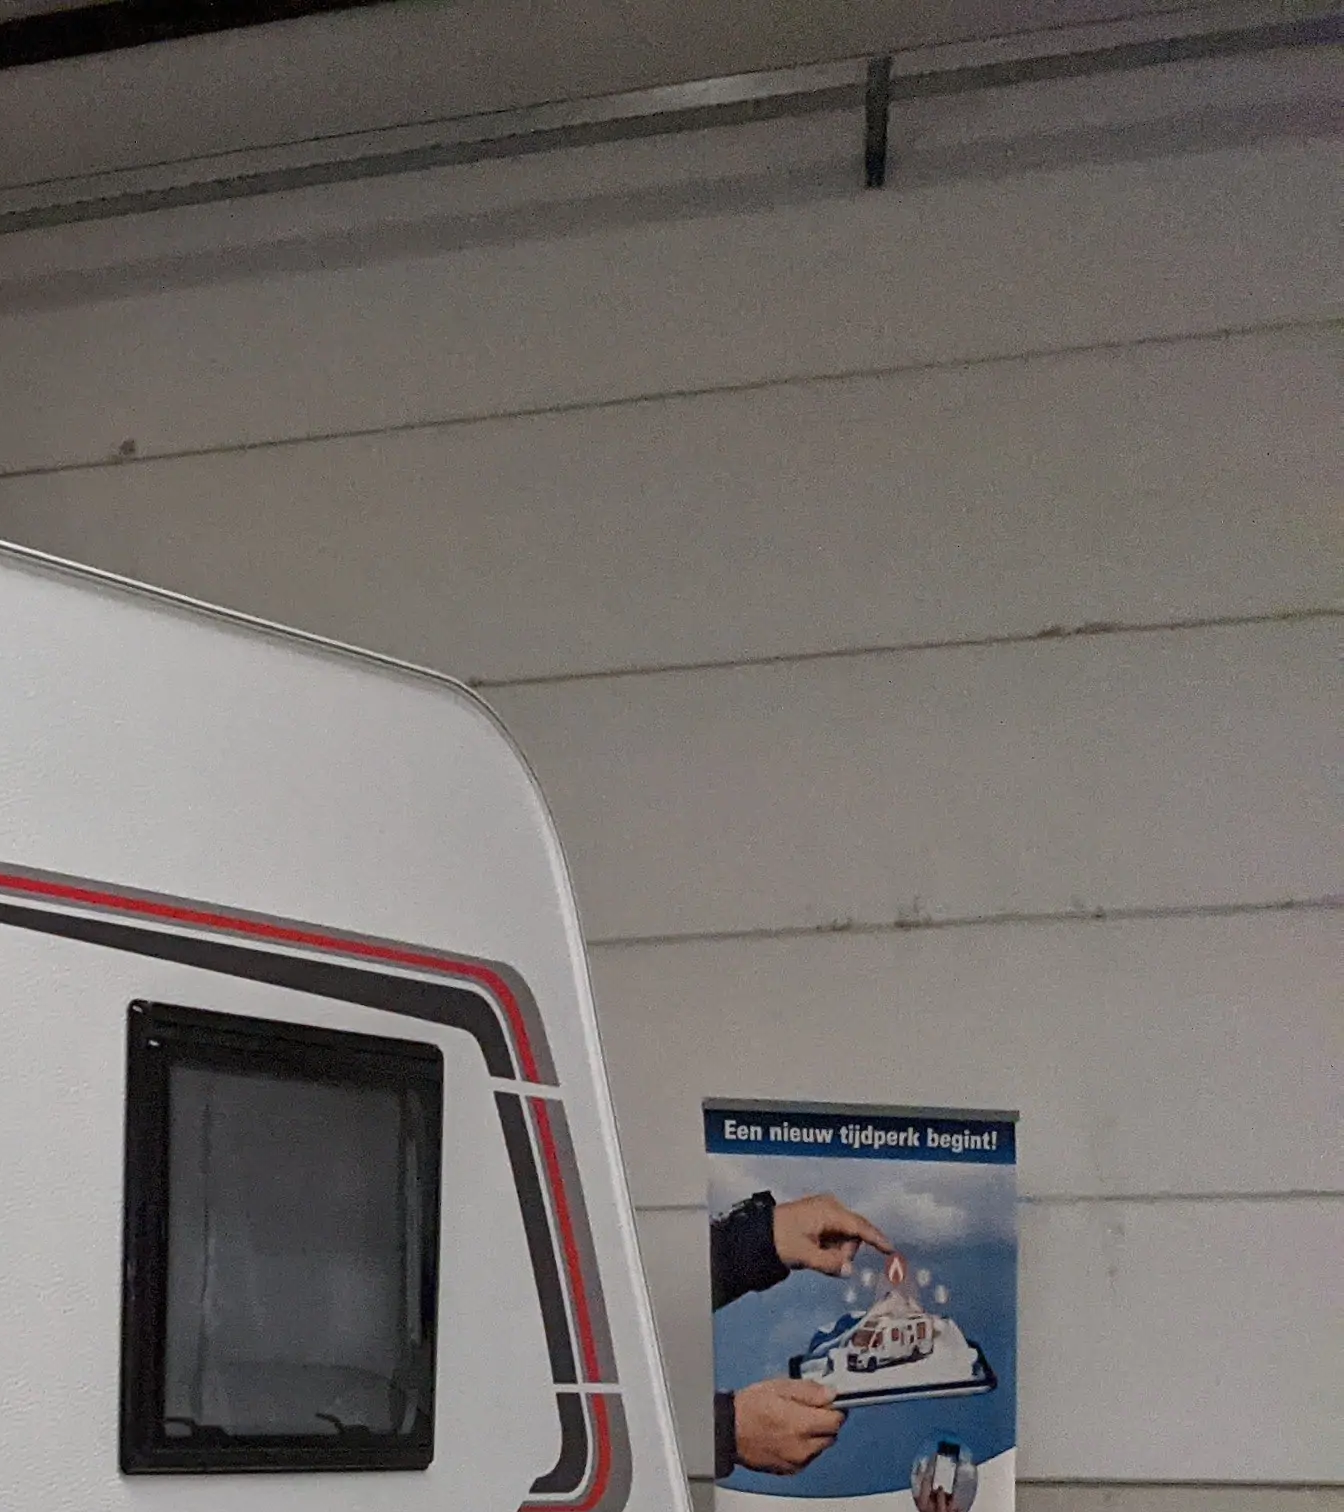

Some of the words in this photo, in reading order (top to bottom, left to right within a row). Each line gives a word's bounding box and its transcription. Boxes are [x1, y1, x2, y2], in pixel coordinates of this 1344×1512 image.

[724, 1119, 762, 1141] Een
[769, 1121, 833, 1143] nieuw
[839, 1124, 920, 1149] tijdperk
[927, 1127, 998, 1153] begint!
